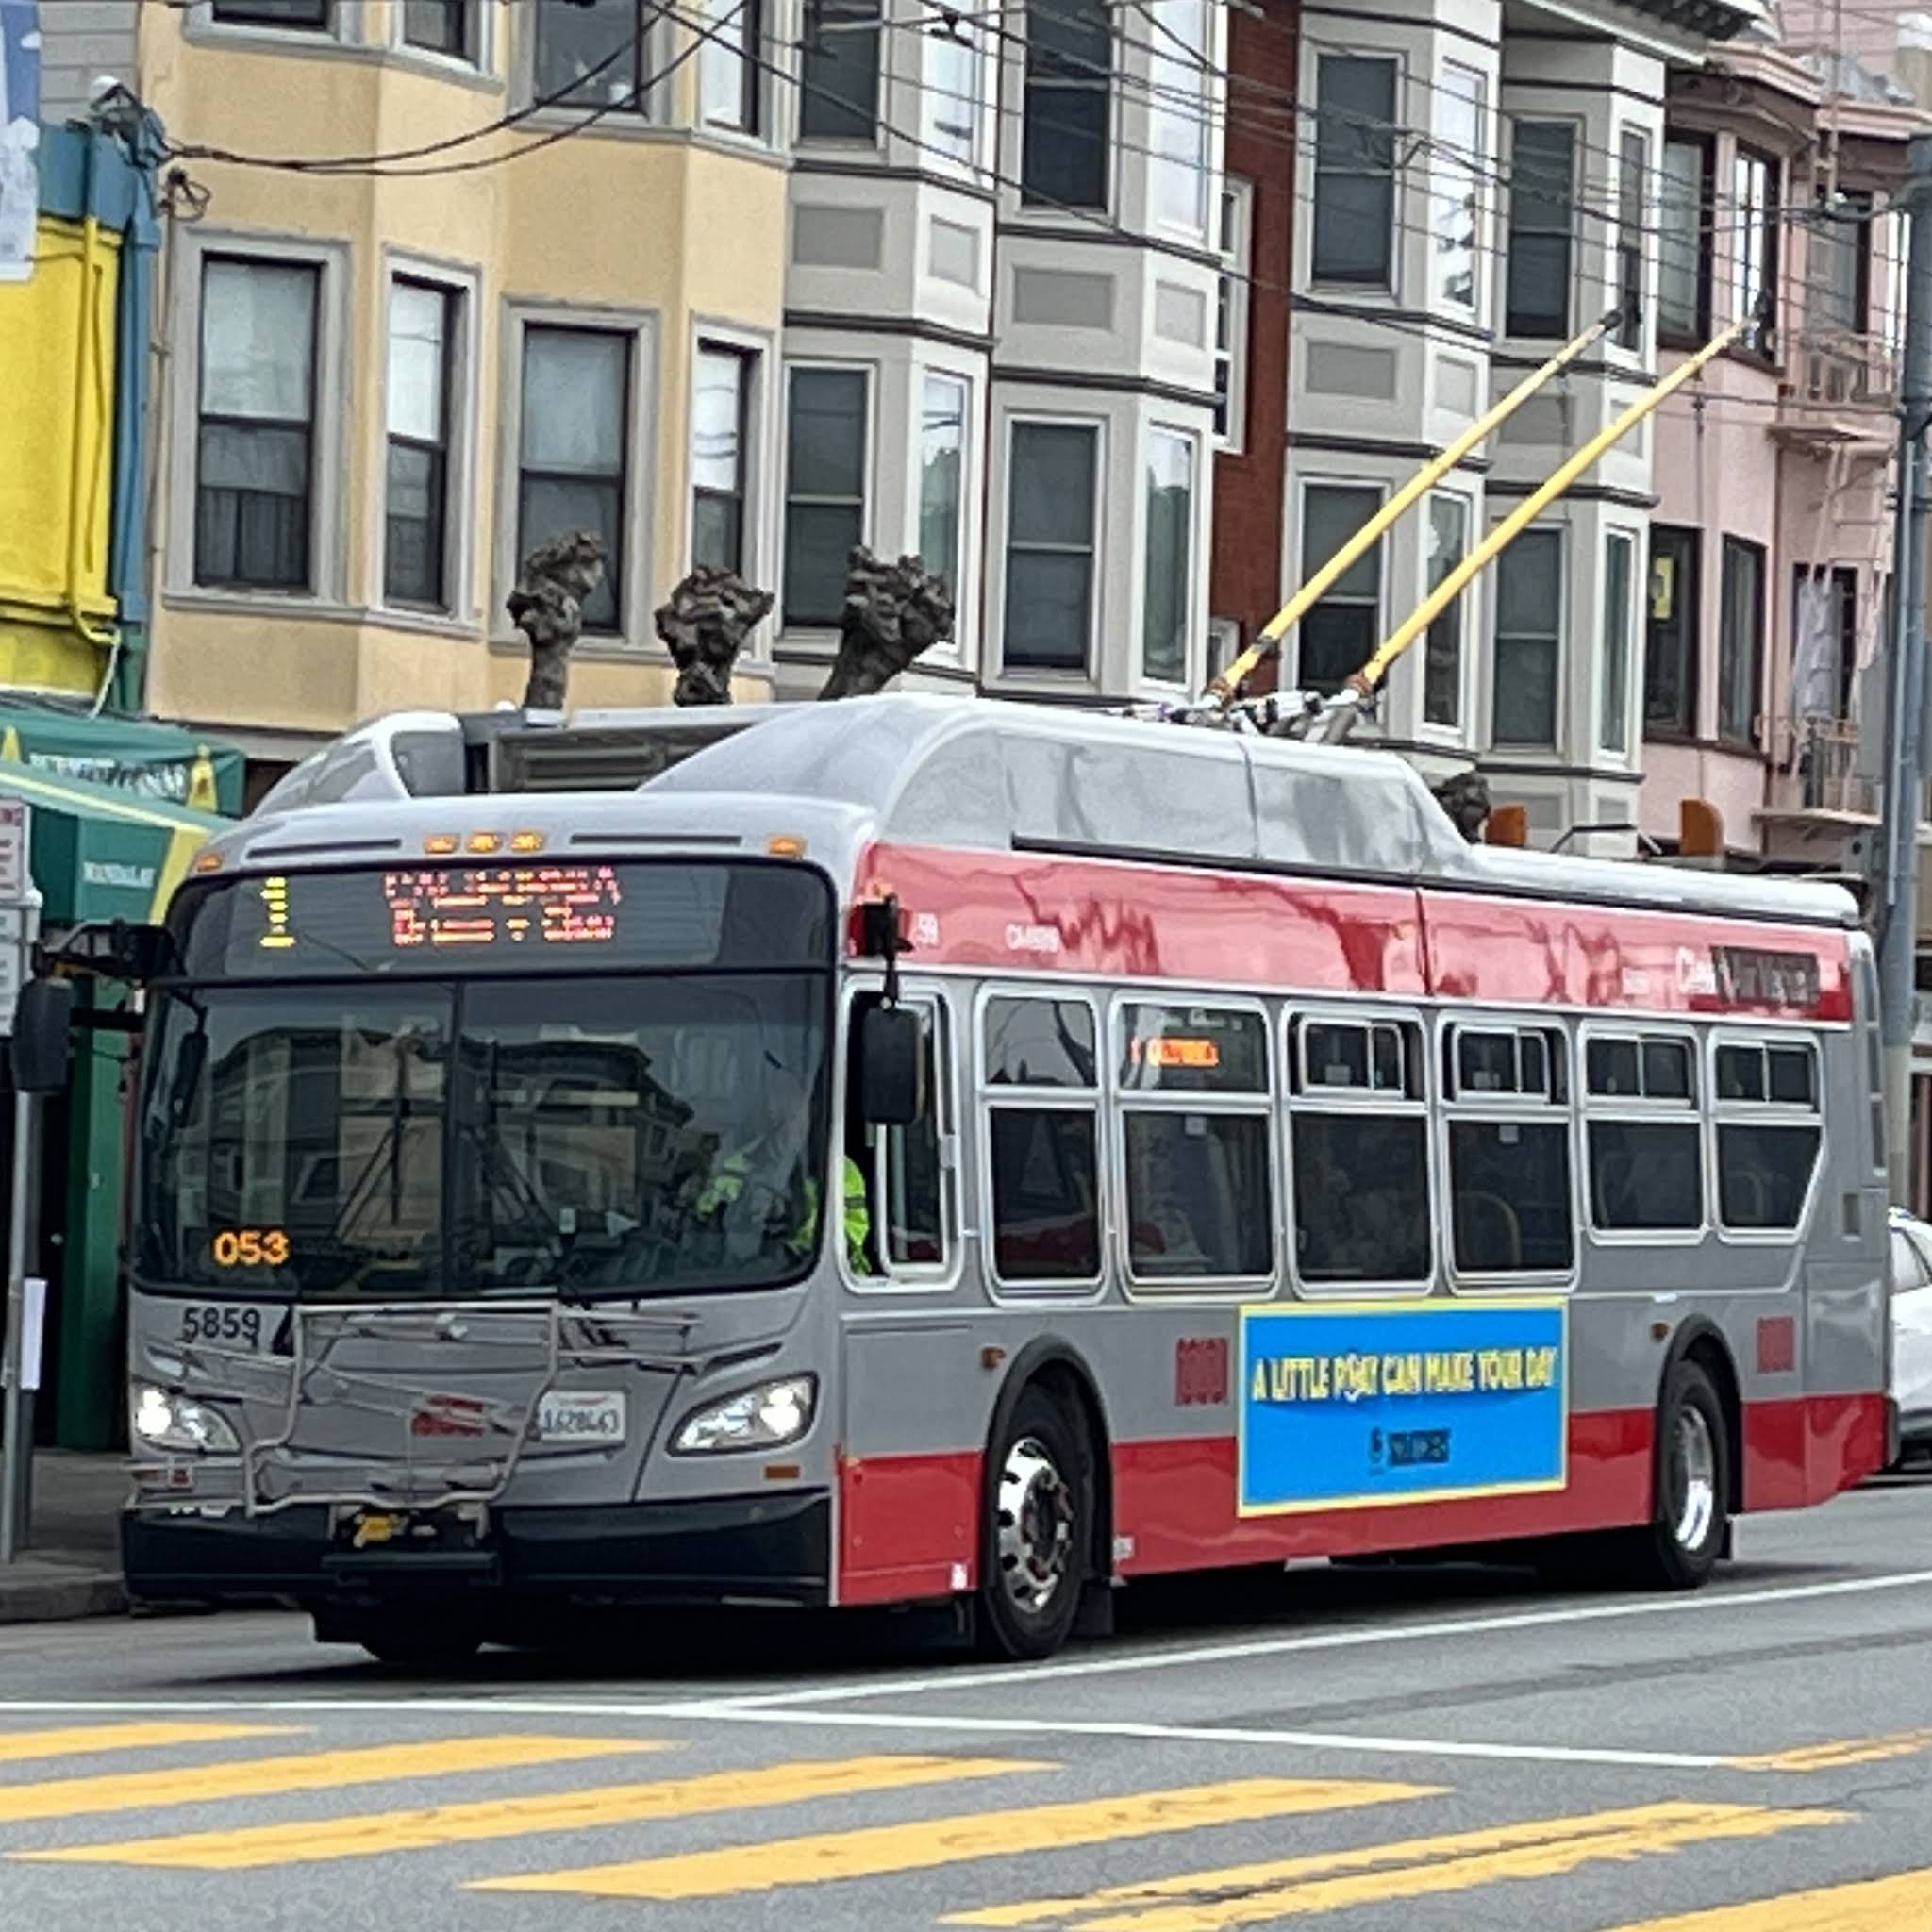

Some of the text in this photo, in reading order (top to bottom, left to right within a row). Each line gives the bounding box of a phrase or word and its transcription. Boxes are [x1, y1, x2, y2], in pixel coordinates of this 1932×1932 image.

[214, 1230, 289, 1265] 053
[183, 1307, 261, 1339] 5859
[1252, 1358, 1266, 1402] A
[1271, 1357, 1329, 1401] LITTLE
[1382, 1353, 1421, 1395] CAN
[1425, 1350, 1474, 1393] MAKE
[1478, 1348, 1524, 1391] YOUR
